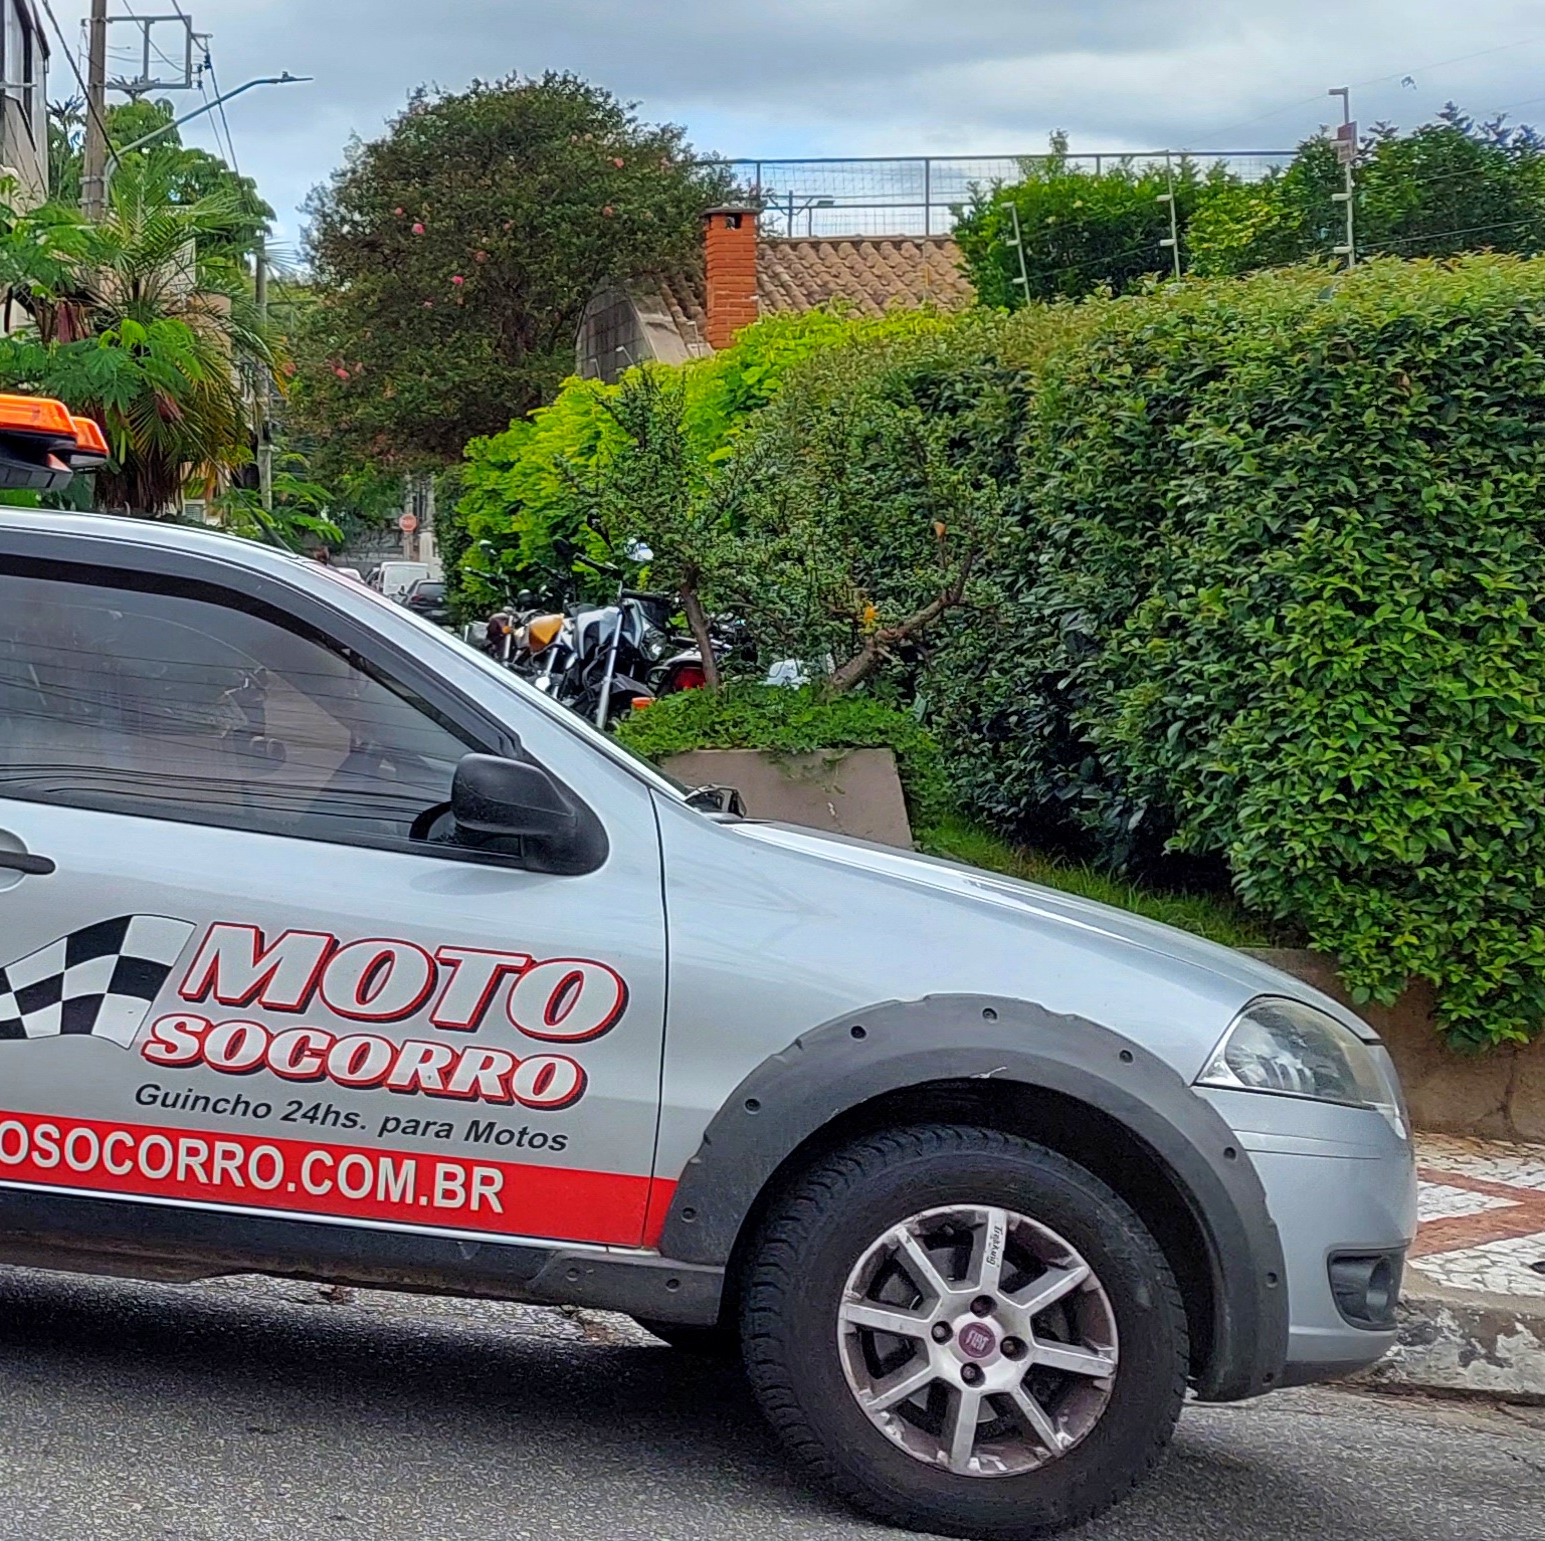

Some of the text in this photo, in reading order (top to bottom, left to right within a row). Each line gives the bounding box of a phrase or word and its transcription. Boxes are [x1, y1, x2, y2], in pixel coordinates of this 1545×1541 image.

[177, 919, 630, 1044] MOTO
[141, 1012, 588, 1112] SOCORRO
[134, 1083, 569, 1152] Guincho 24hs. para Motos
[965, 1330, 989, 1350] FIAT
